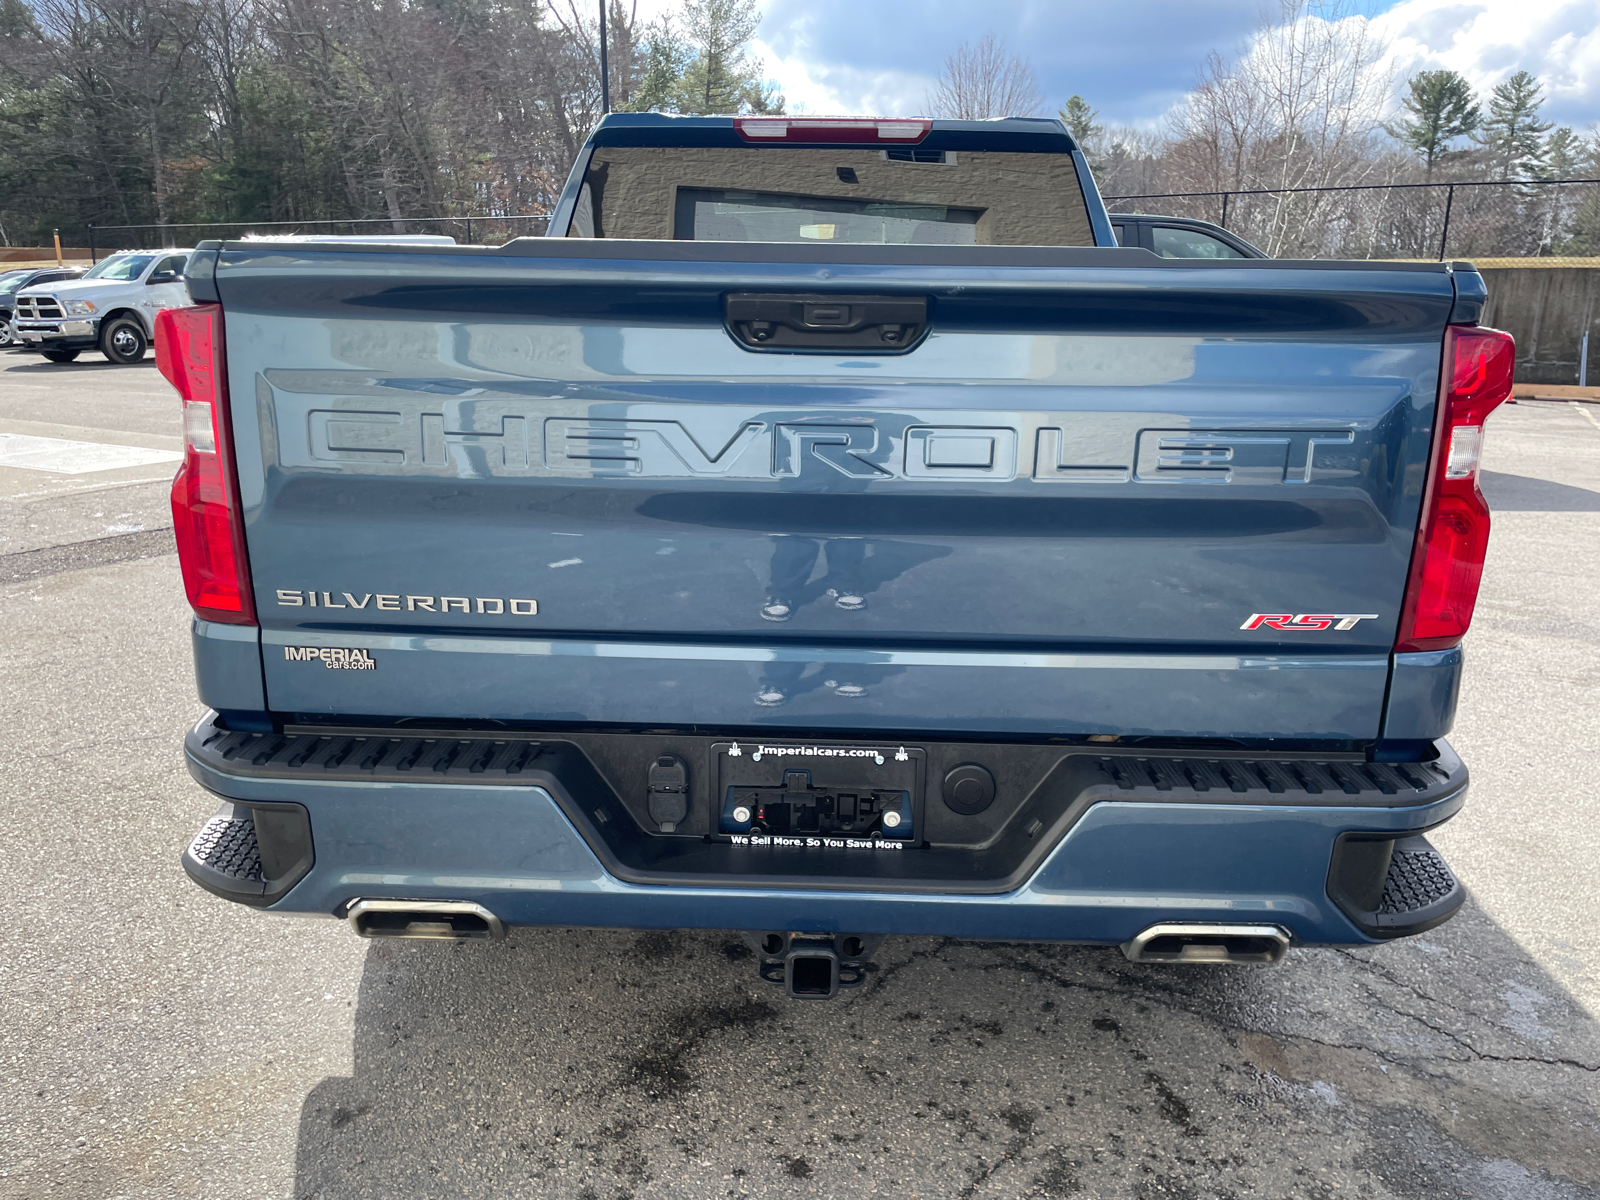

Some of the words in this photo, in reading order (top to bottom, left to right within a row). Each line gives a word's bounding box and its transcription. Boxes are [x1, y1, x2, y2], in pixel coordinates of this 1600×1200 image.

[307, 408, 1356, 485] CHEVROLET
[275, 588, 539, 616] SILVERADO
[1239, 612, 1379, 631] RST
[284, 646, 375, 663] IMPERIAL
[325, 659, 376, 670] cars.com
[757, 745, 879, 758] Imperialcars.com
[731, 835, 749, 845] We
[750, 835, 771, 846] Sell
[773, 837, 804, 847] More,
[806, 837, 821, 847] So
[823, 838, 844, 849] You
[846, 839, 873, 849] Save
[875, 840, 903, 850] More
